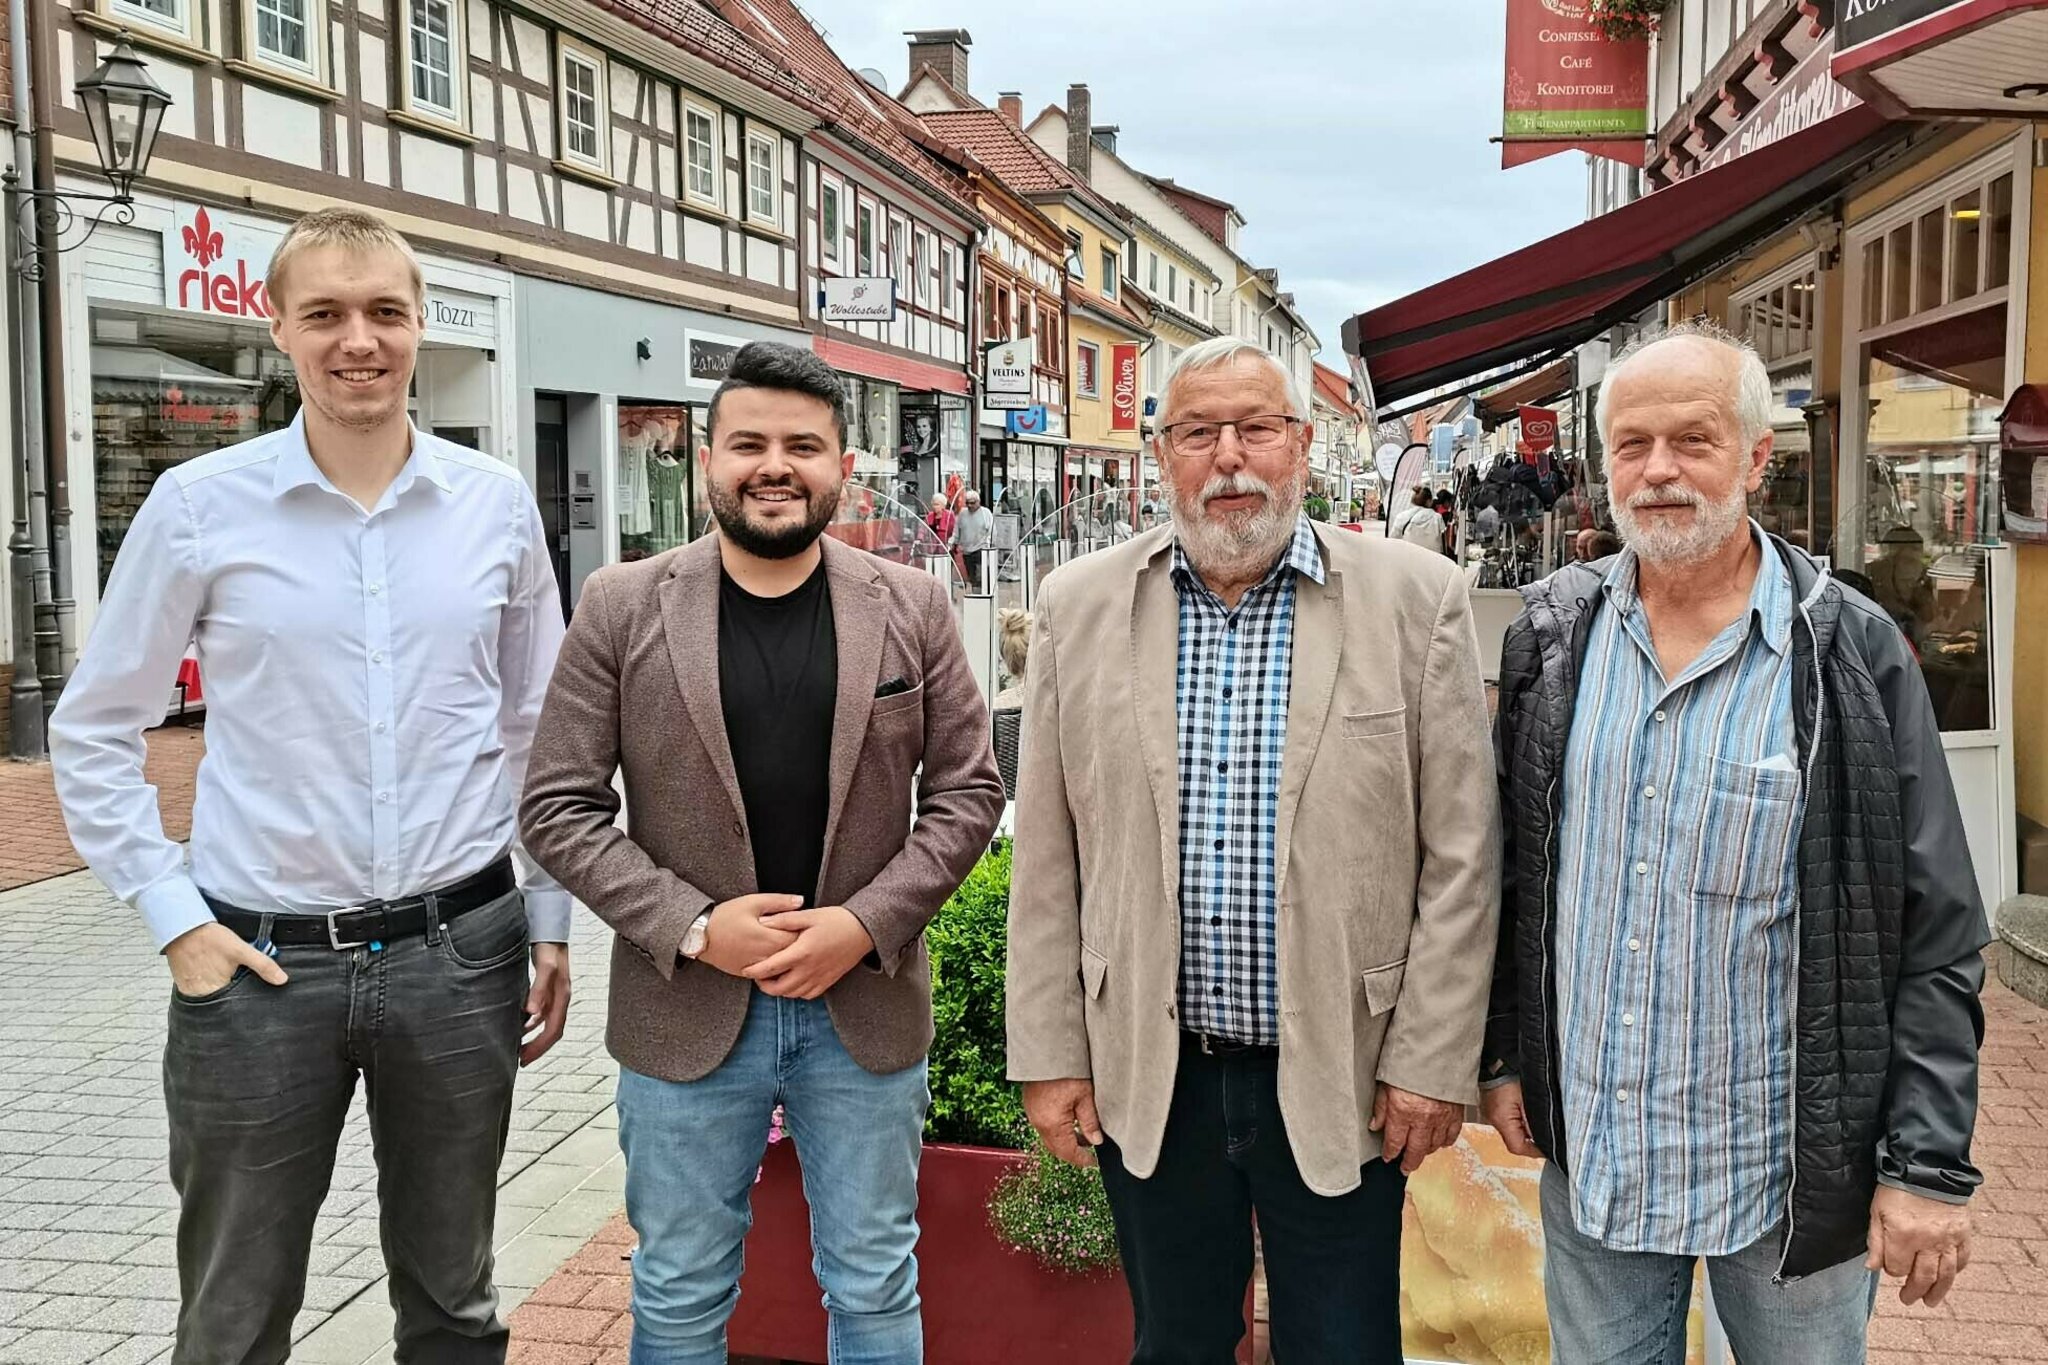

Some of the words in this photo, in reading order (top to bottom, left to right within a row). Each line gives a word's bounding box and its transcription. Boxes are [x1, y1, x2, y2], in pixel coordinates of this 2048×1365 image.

[1539, 29, 1600, 42] CONFISSE
[1560, 55, 1592, 69] CAFÉ
[1537, 82, 1614, 96] KONDITOREI
[432, 300, 474, 327] TOZZI
[830, 303, 888, 315] Wollestube
[992, 368, 1025, 377] VELTINS
[1114, 357, 1135, 419] s.Oliver
